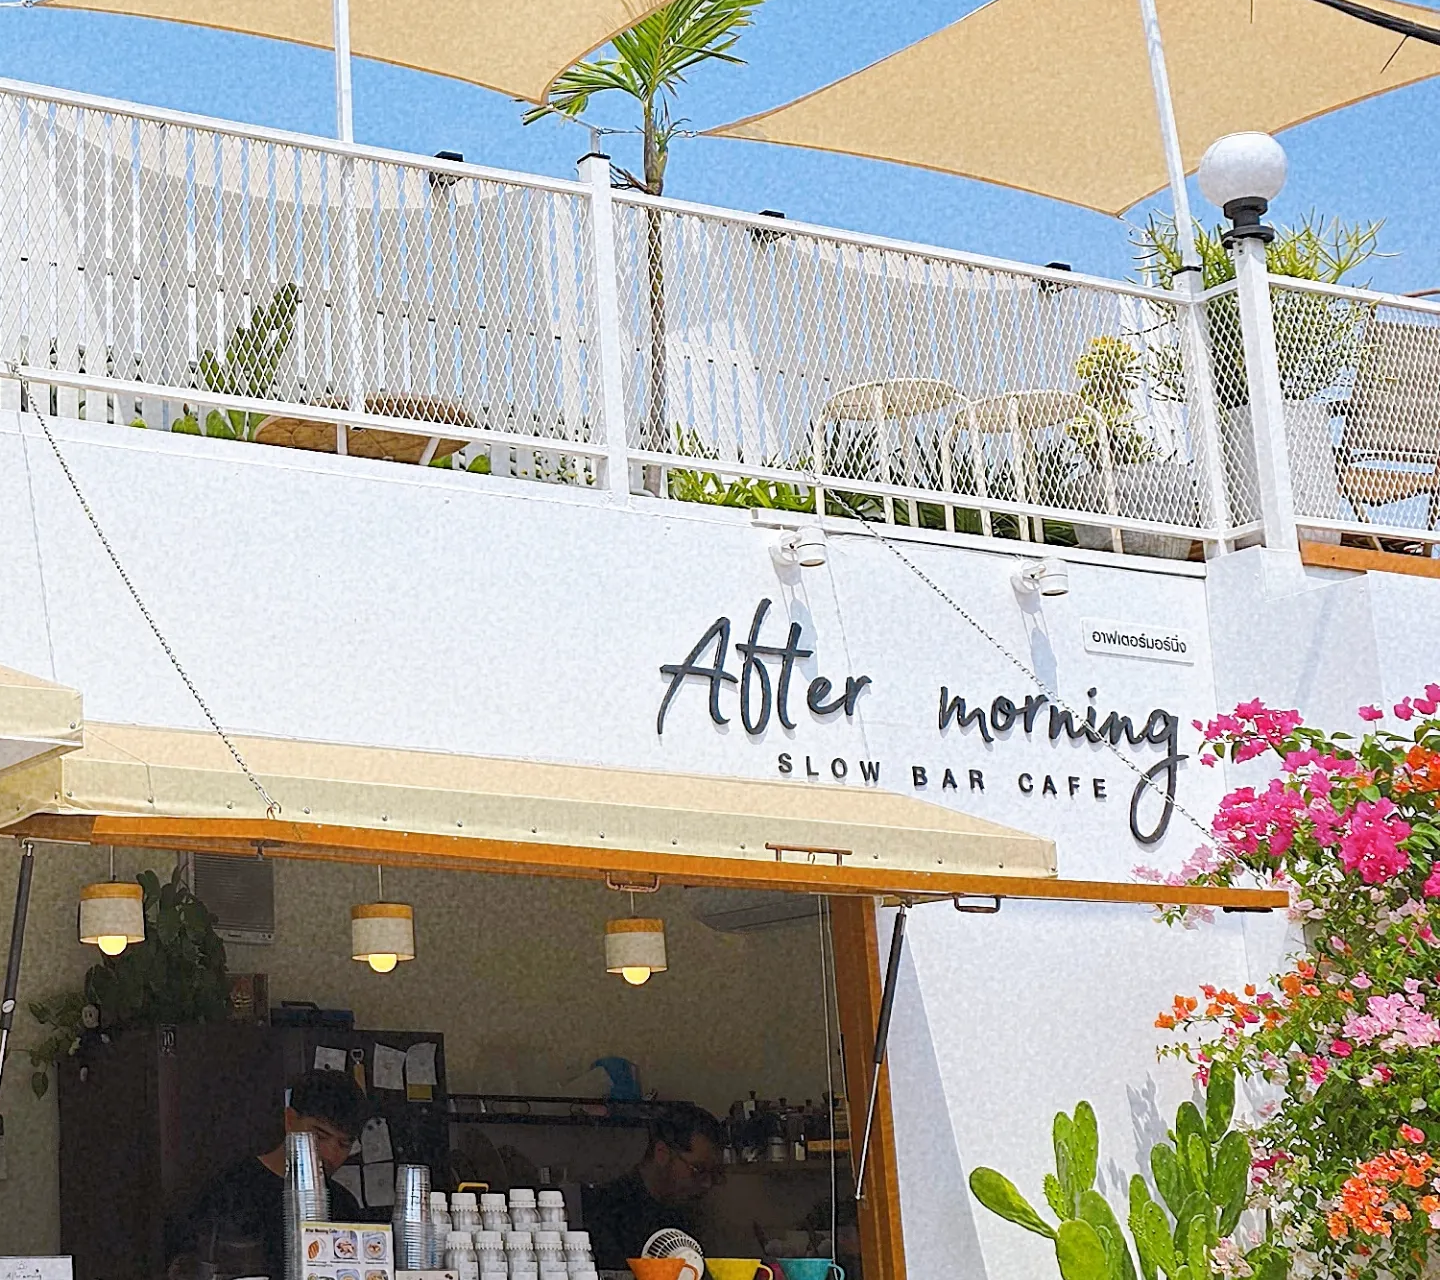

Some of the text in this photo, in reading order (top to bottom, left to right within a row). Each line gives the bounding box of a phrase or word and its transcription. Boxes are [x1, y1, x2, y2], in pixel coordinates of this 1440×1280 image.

[657, 598, 1189, 845] After morning
[777, 752, 1107, 800] SLOW BAR CAFE
